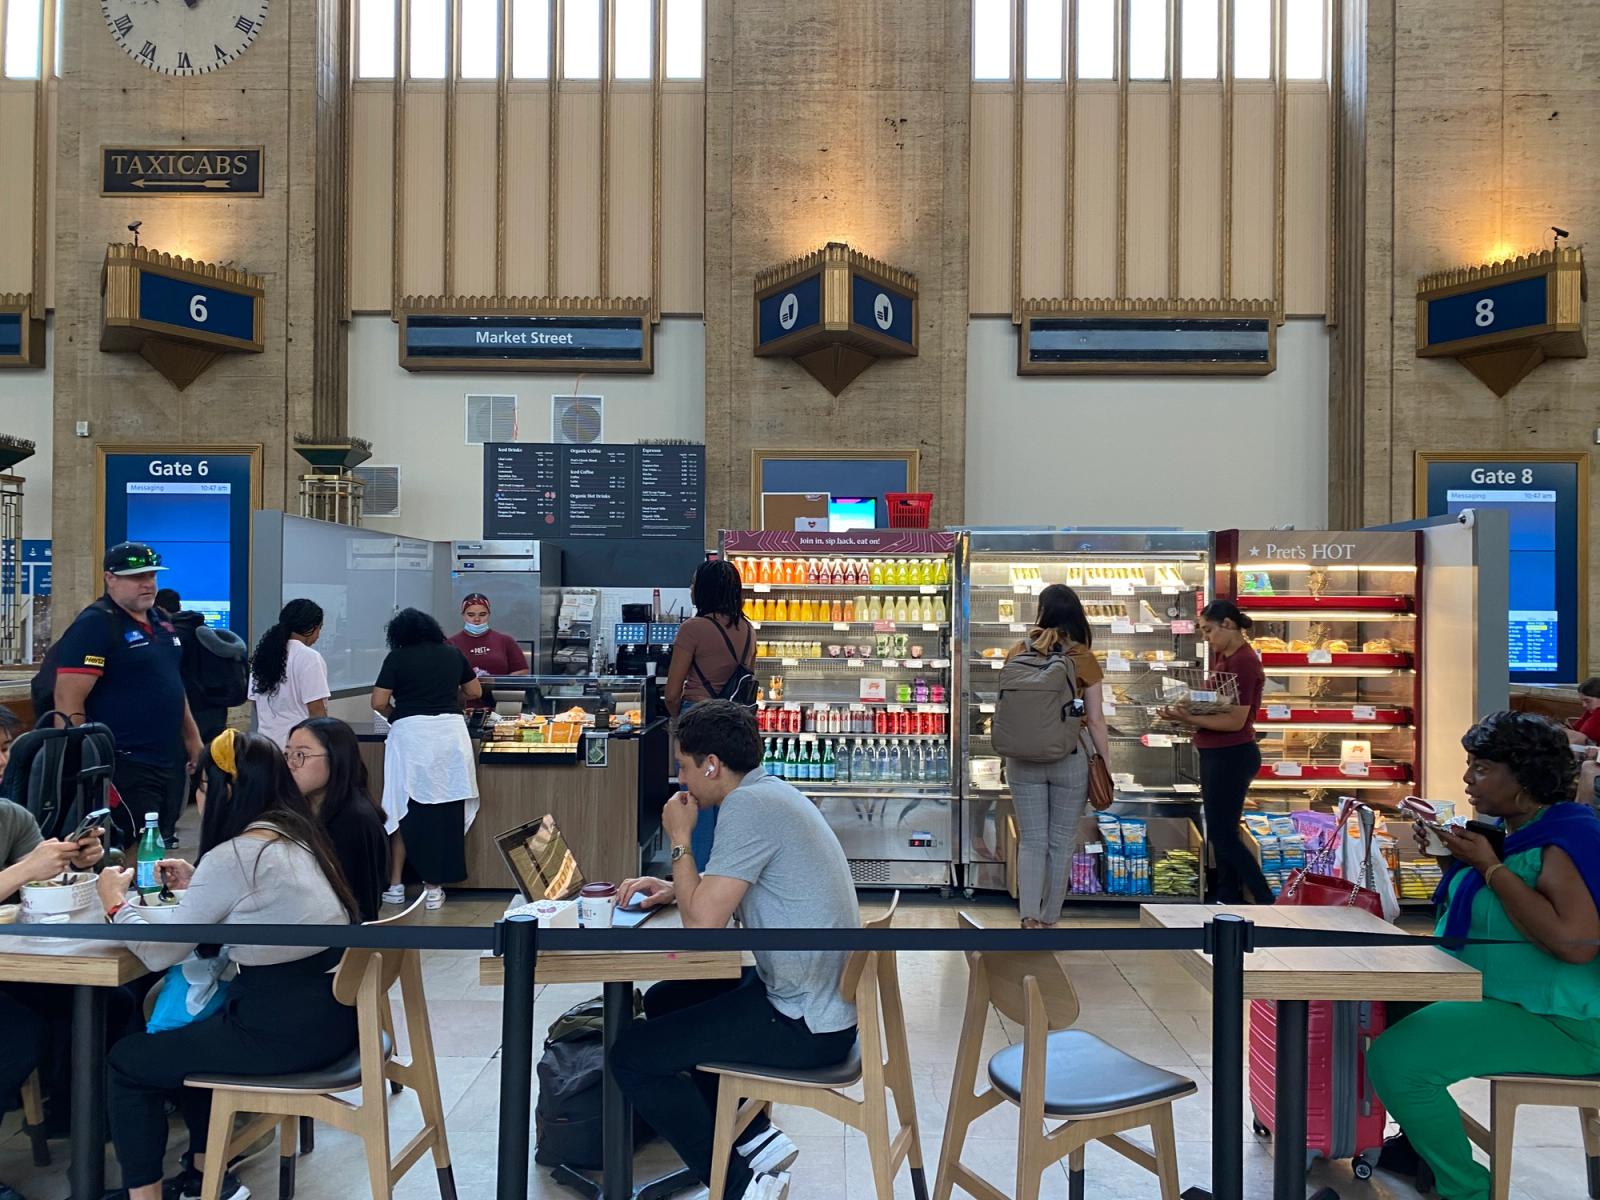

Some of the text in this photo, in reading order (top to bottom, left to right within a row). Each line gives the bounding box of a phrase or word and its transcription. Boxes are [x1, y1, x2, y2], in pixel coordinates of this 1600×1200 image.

[111, 155, 248, 175] TAXICABS
[190, 294, 208, 322] 6
[1475, 298, 1495, 326] 8
[476, 331, 573, 344] Market Street
[149, 460, 209, 476] Gate 6
[1471, 468, 1533, 484] Gate 8
[800, 537, 814, 545] Join
[825, 538, 836, 546] sip
[1311, 543, 1356, 560] HOT
